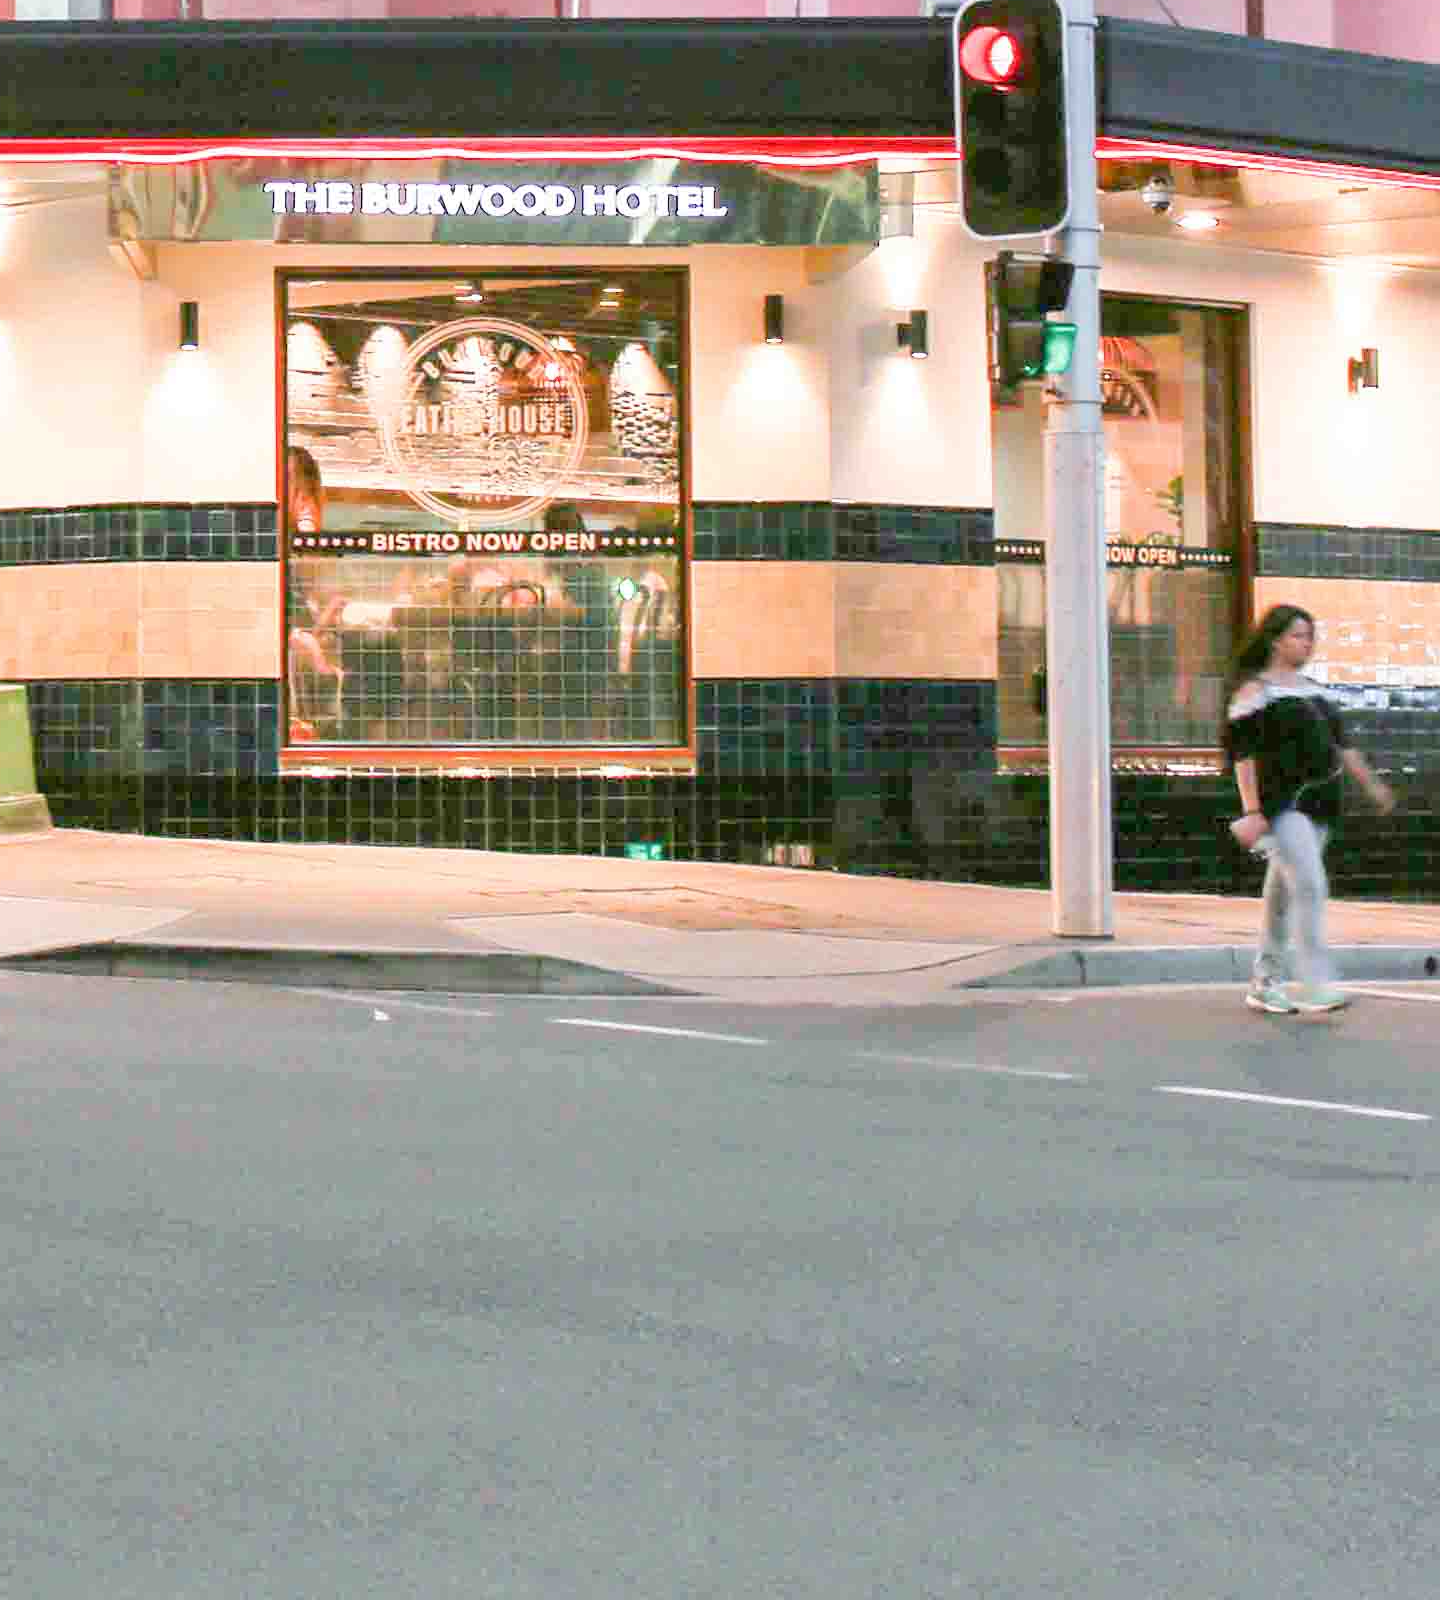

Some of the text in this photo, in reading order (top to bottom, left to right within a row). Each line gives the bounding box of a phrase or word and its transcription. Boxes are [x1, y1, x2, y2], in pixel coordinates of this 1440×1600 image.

[264, 181, 728, 217] THE BURWOOD HOTEL
[371, 533, 597, 552] BISTRO NOW OPEN
[1138, 548, 1177, 564] OPEN
